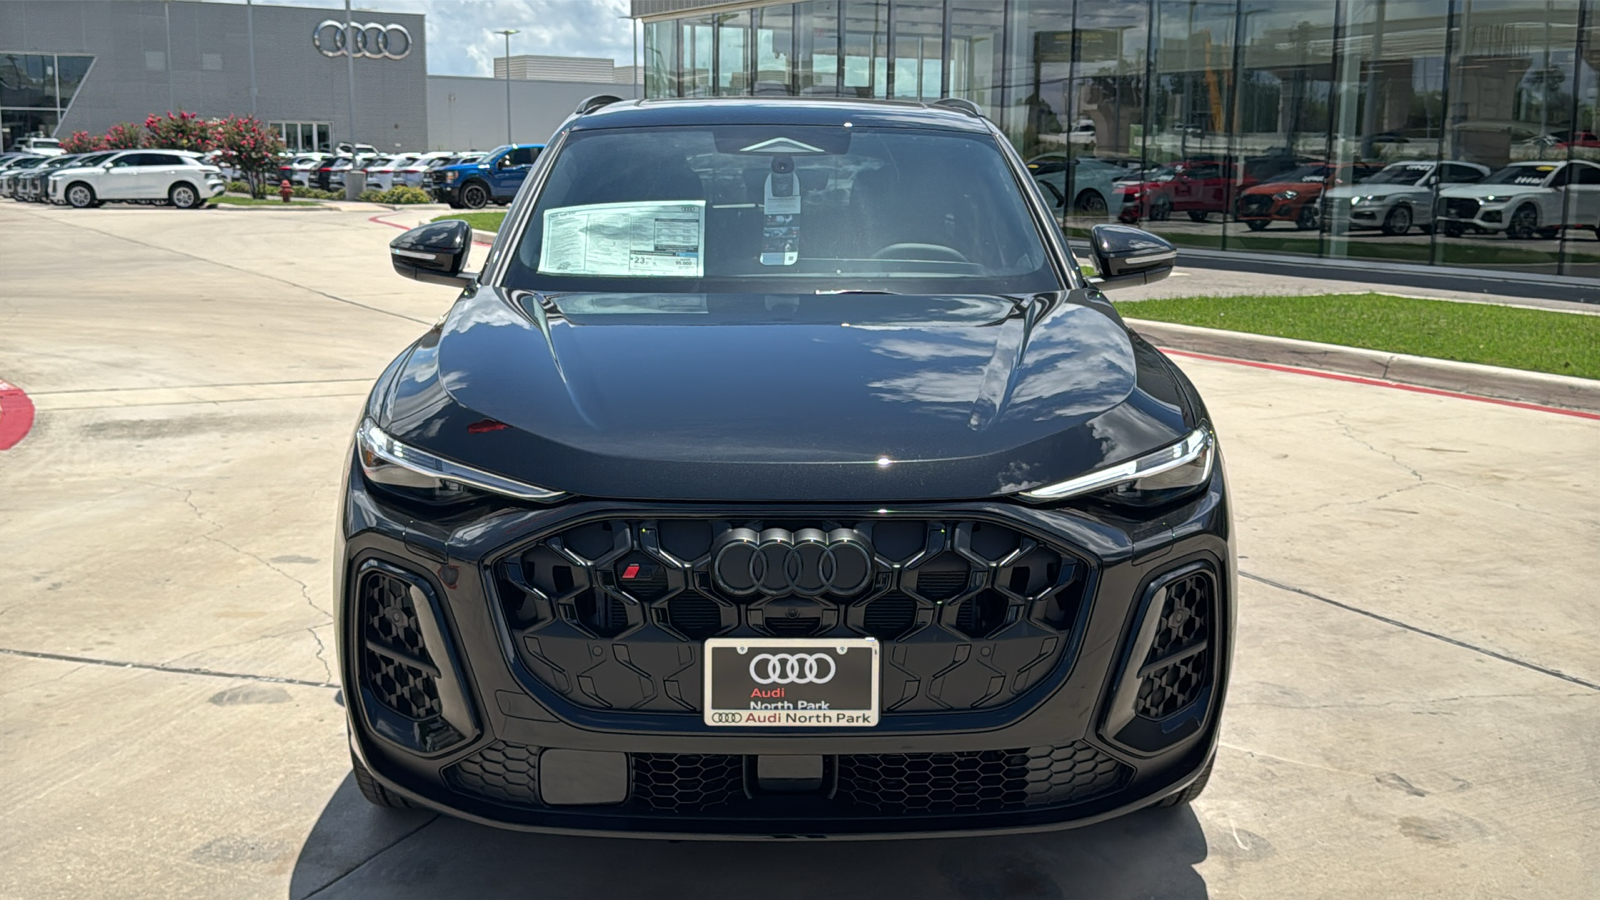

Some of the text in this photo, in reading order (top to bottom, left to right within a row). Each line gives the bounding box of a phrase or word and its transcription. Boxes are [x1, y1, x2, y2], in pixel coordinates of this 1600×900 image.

[750, 687, 785, 698] Audi
[750, 700, 830, 710] North Park
[745, 713, 871, 723] Audi North Park
